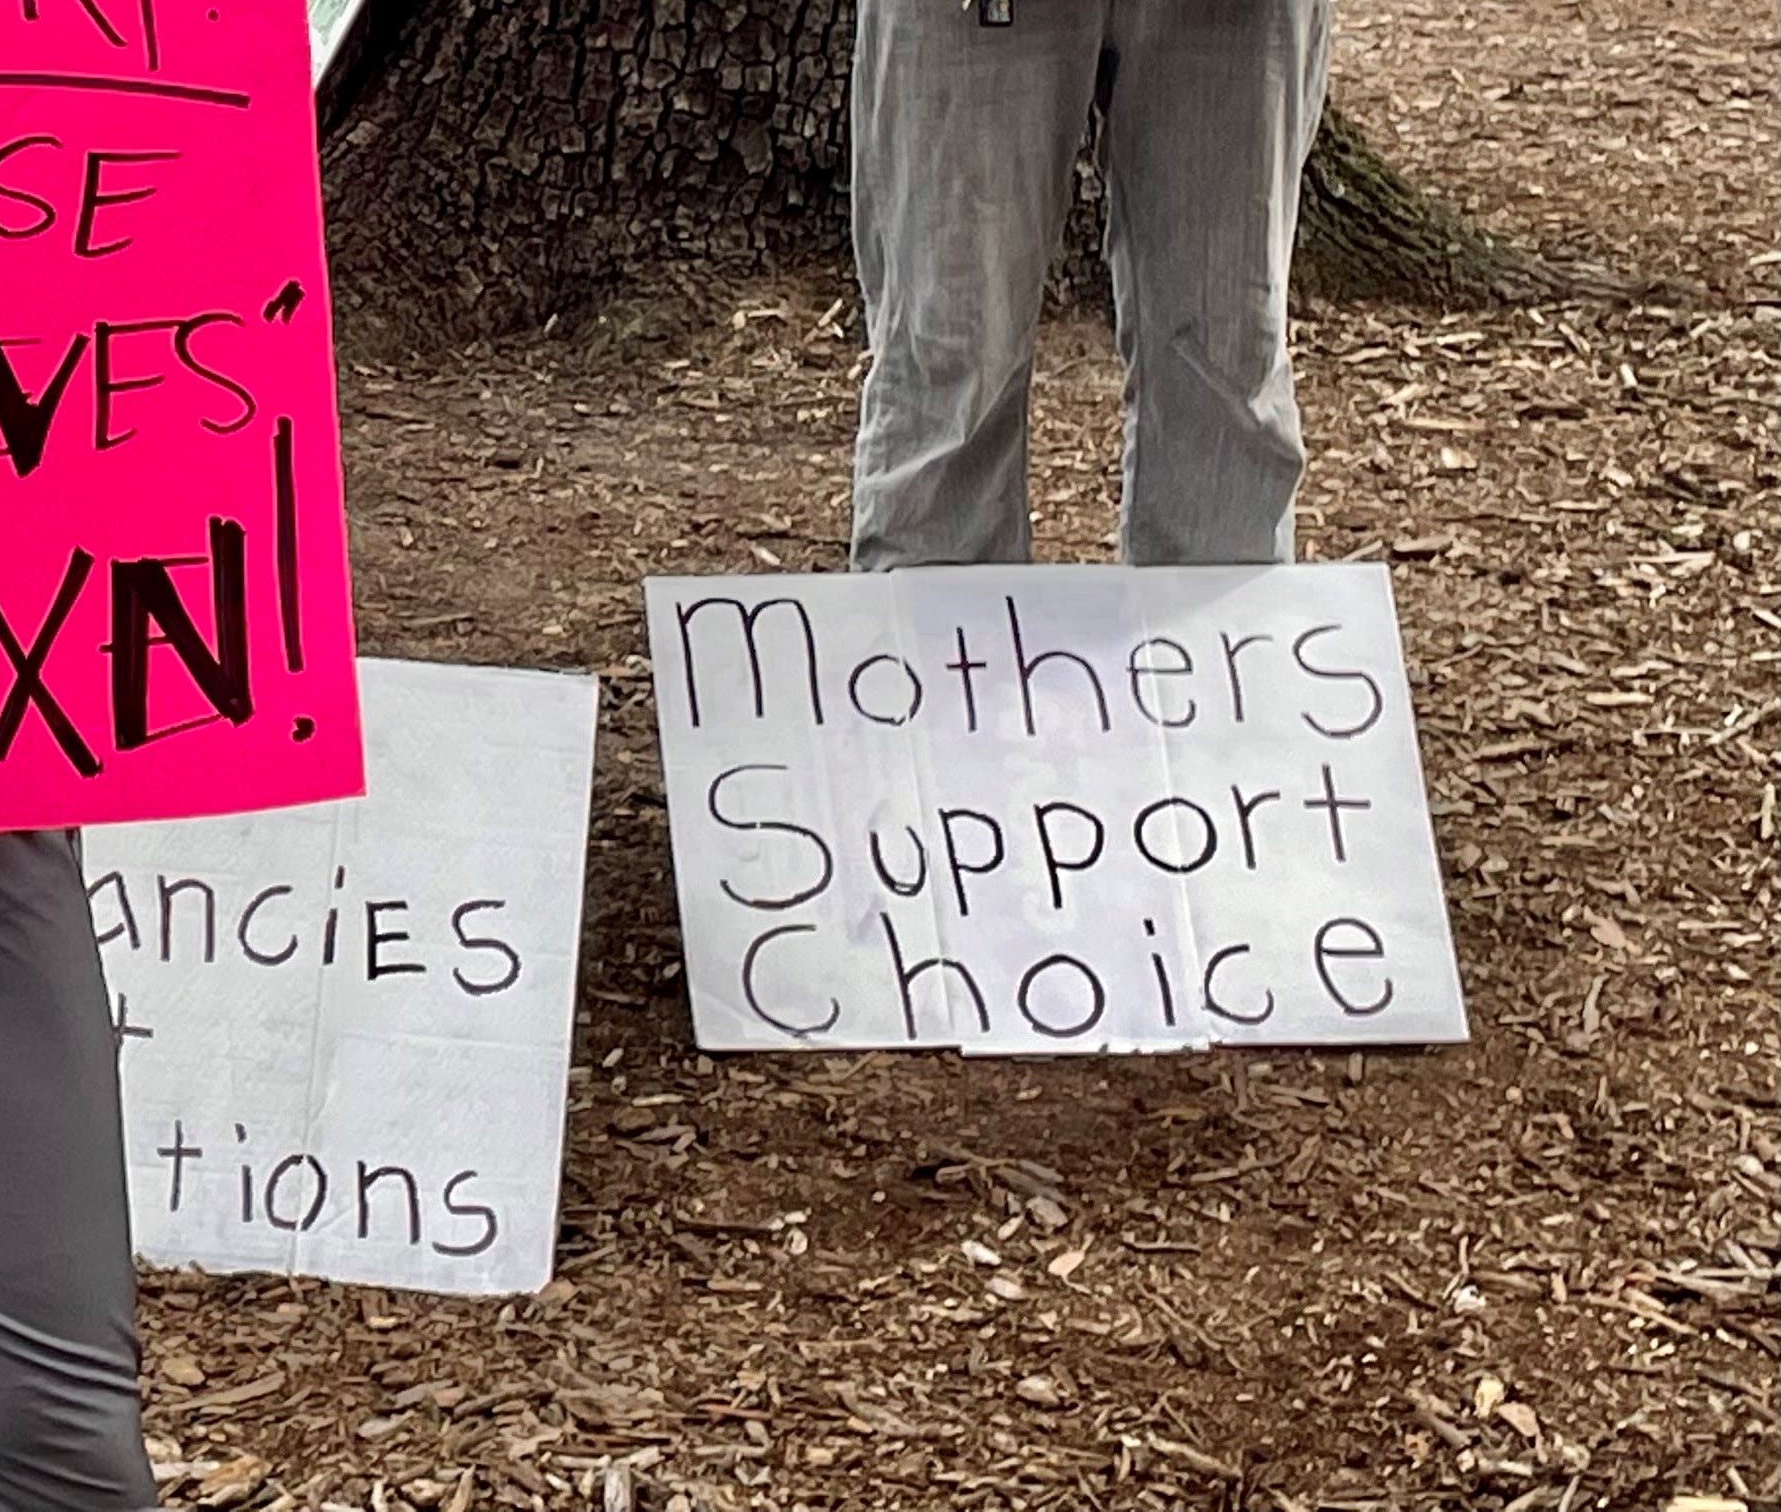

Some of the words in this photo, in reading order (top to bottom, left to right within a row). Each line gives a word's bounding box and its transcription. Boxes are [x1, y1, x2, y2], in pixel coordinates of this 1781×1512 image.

[675, 594, 1384, 740] Mothers
[708, 763, 1372, 916] Support
[742, 911, 1395, 1041] Choice
